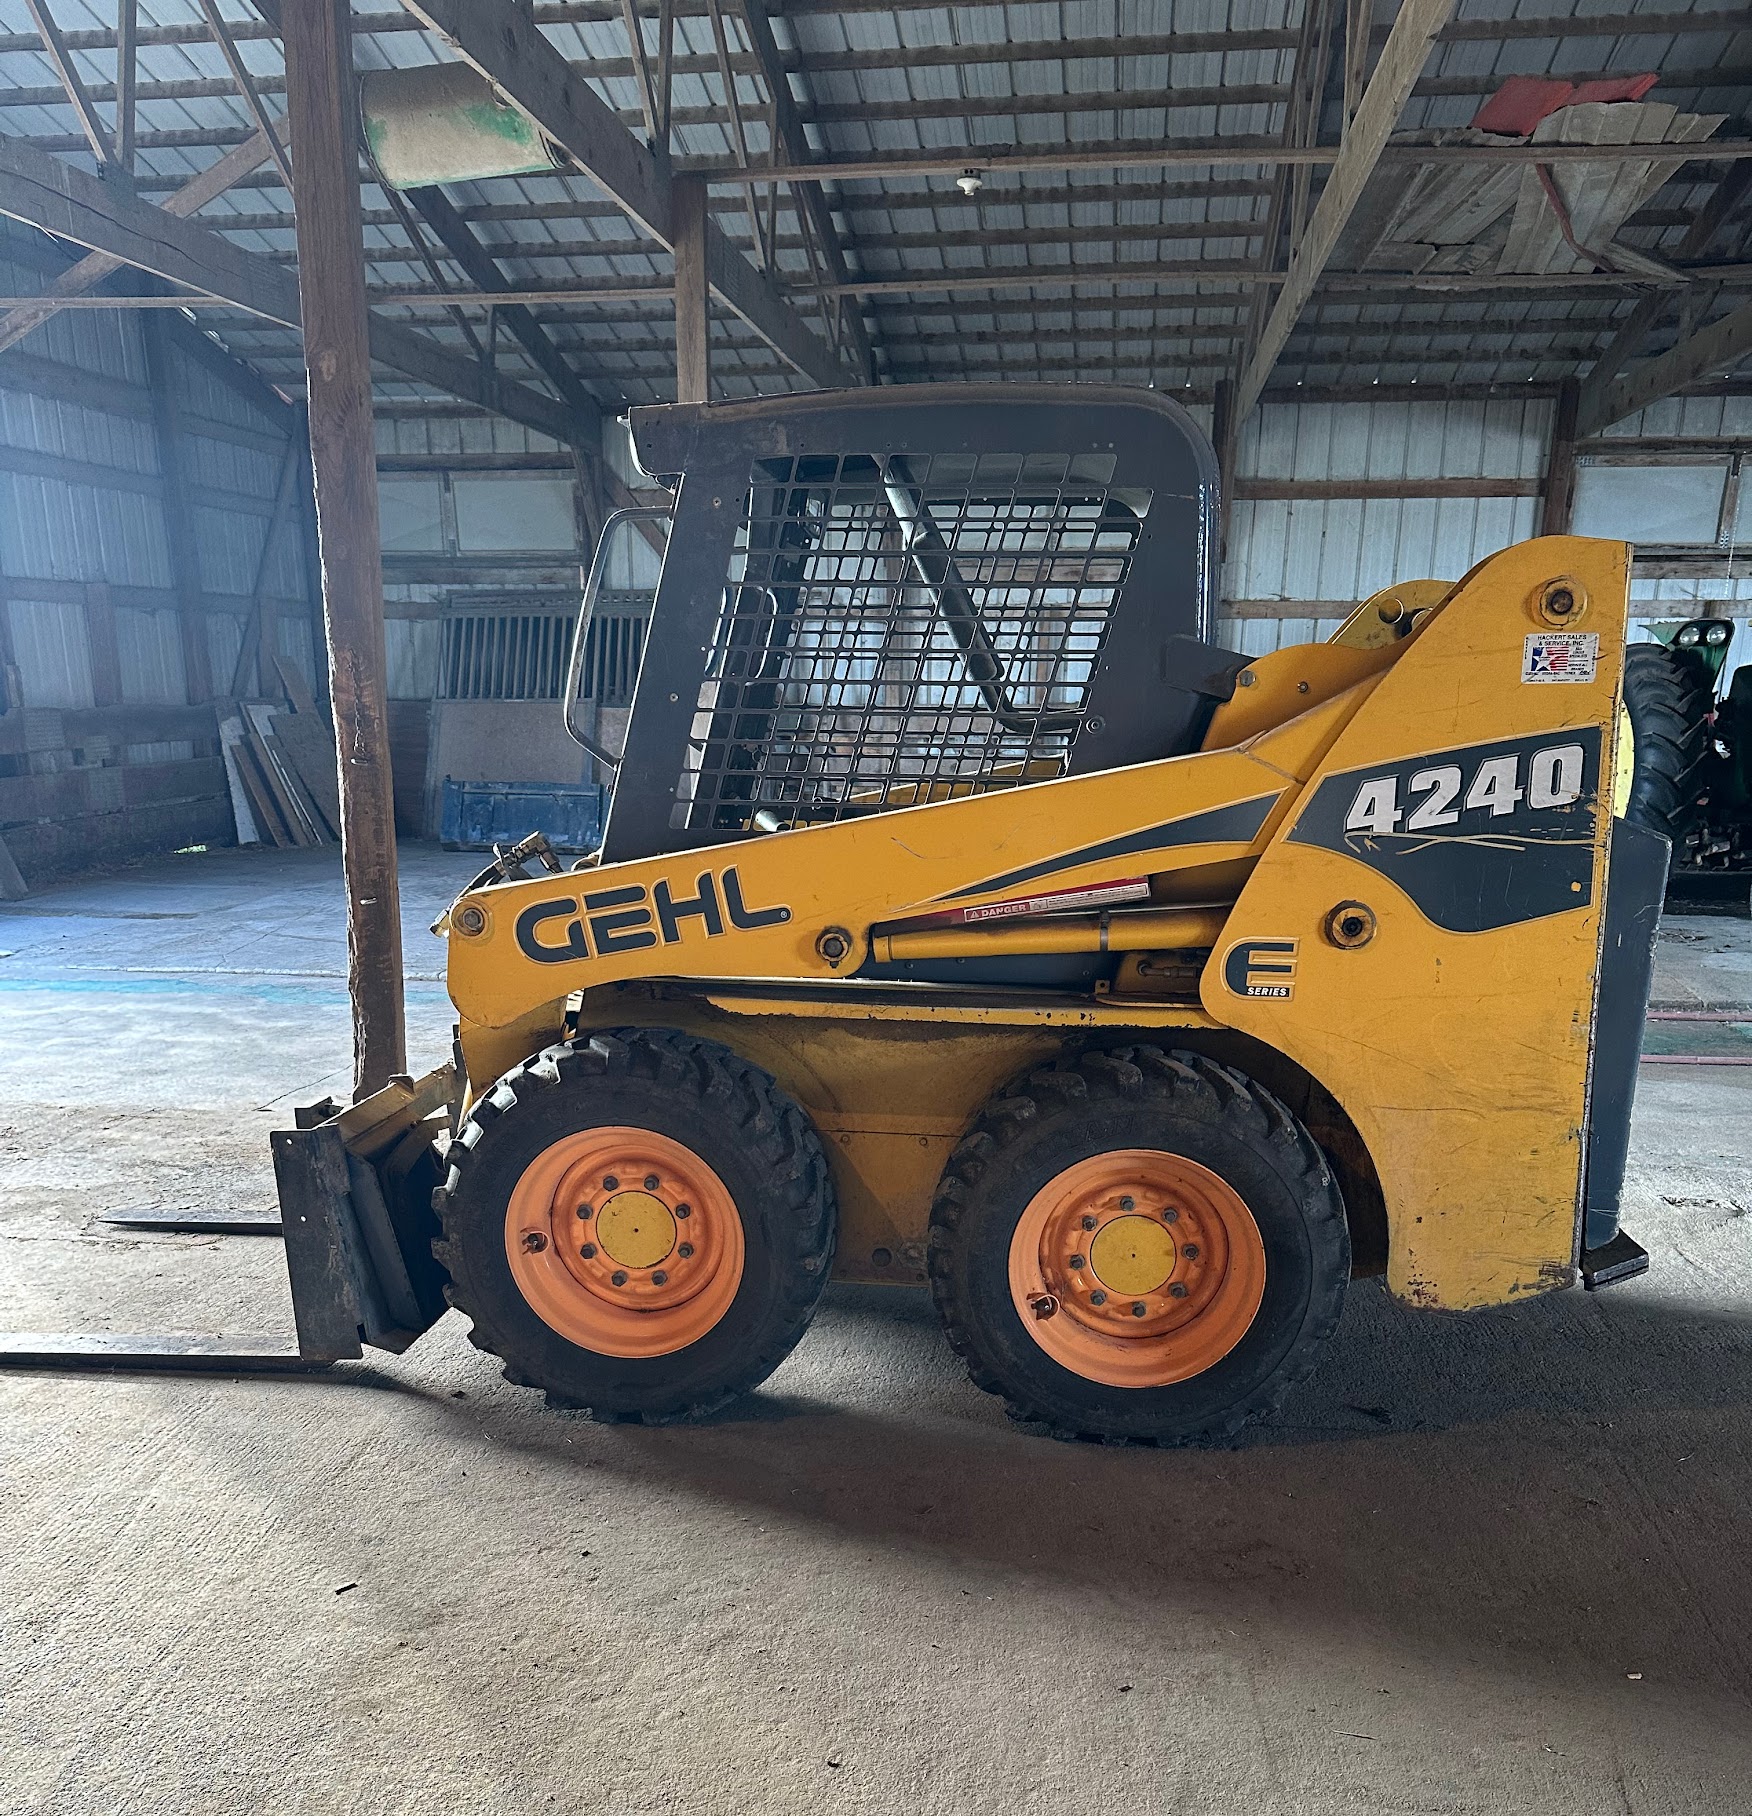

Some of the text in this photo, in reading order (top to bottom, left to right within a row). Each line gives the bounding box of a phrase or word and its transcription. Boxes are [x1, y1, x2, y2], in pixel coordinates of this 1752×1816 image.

[1345, 744, 1584, 833] 4240
[515, 865, 792, 963] GEHL
[981, 904, 1026, 917] DANGER
[1223, 939, 1297, 999] E
[1247, 987, 1287, 996] SERIES
